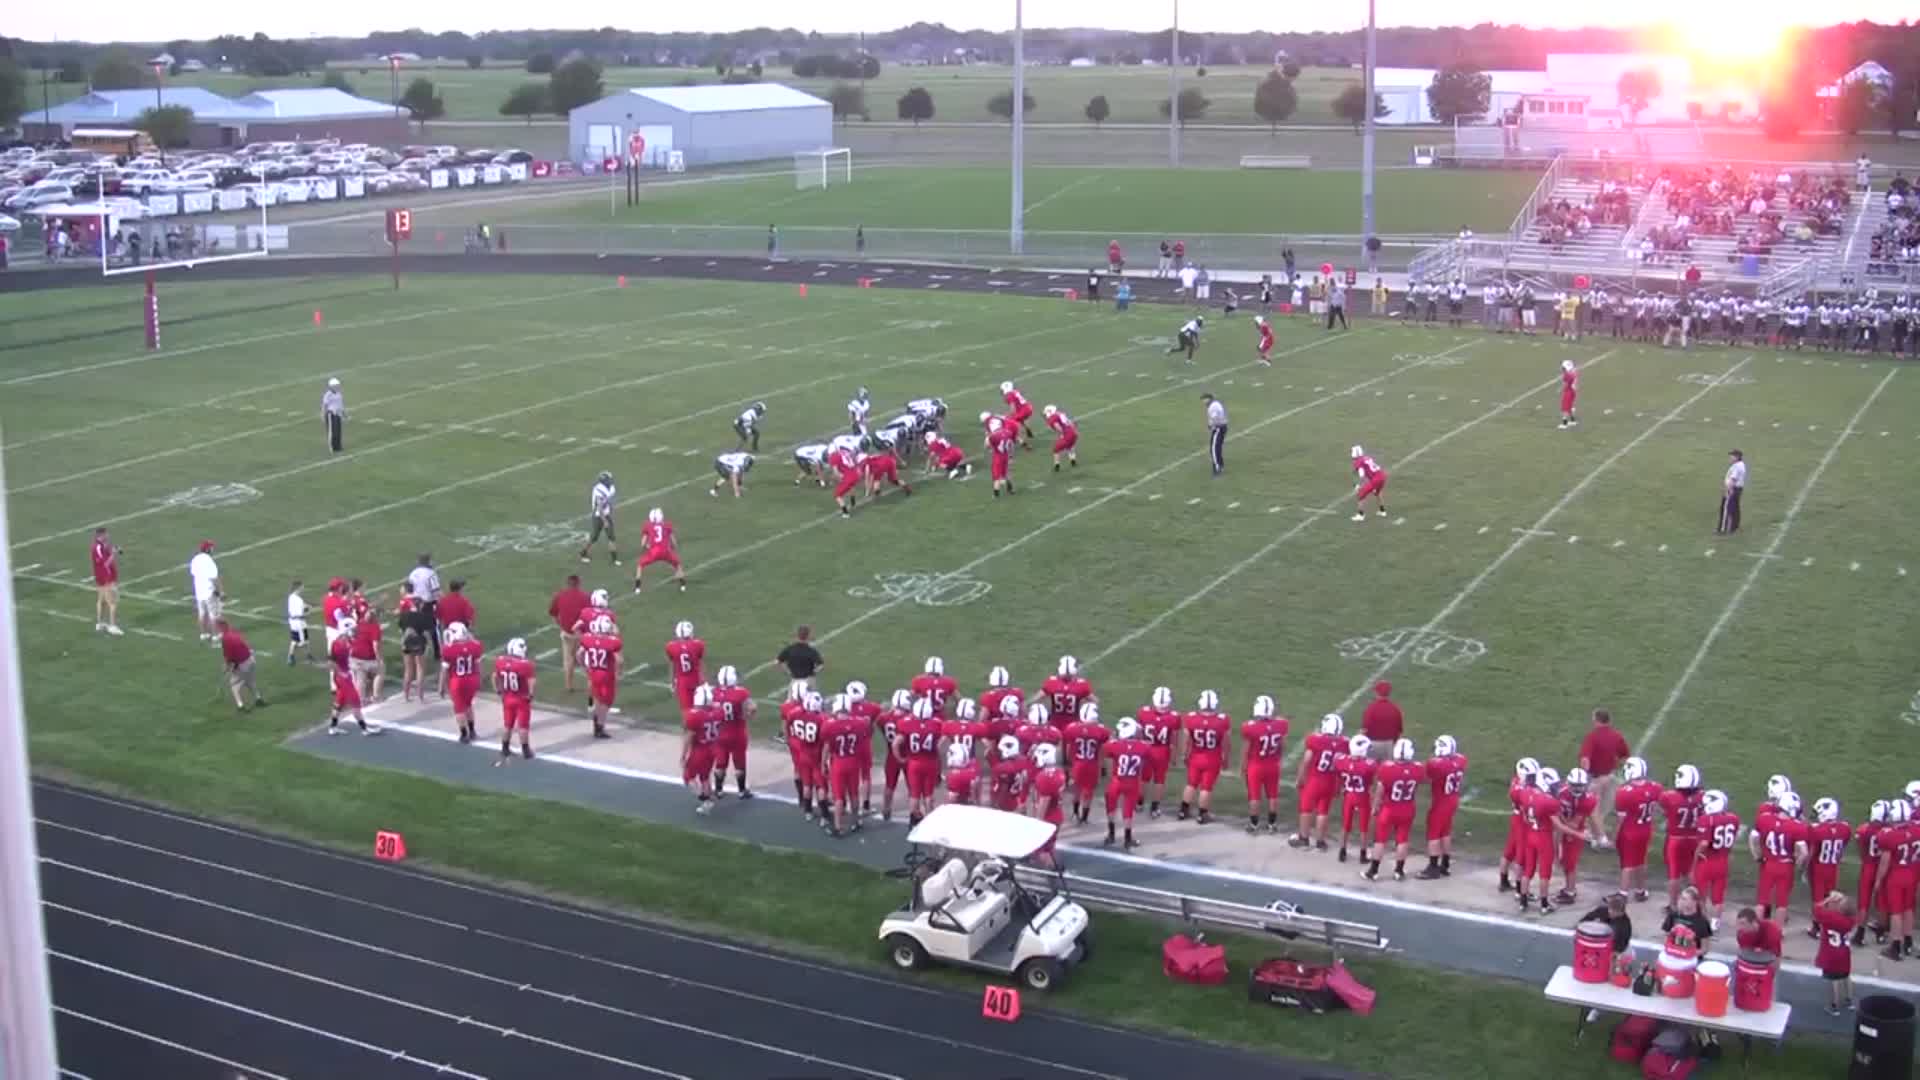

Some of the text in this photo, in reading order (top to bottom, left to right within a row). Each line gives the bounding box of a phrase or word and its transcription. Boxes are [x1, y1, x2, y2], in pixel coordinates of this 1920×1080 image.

[395, 210, 410, 232] 13
[653, 525, 664, 543] 3
[456, 656, 473, 676] 61
[588, 648, 607, 668] 32
[679, 651, 691, 673] 6
[500, 672, 519, 691] 78
[1054, 693, 1076, 713] 53
[793, 720, 817, 742] 68
[885, 722, 897, 743] 6
[1144, 725, 1168, 745] 54
[1194, 729, 1217, 749] 56
[909, 733, 933, 753] 64
[1075, 738, 1096, 760] 36
[1260, 734, 1281, 756] 75
[1118, 755, 1141, 776] 82
[1318, 750, 1332, 772] 6
[378, 835, 396, 857] 30
[1713, 825, 1736, 850] 56
[1766, 831, 1787, 856] 41
[987, 990, 1012, 1016] 40
